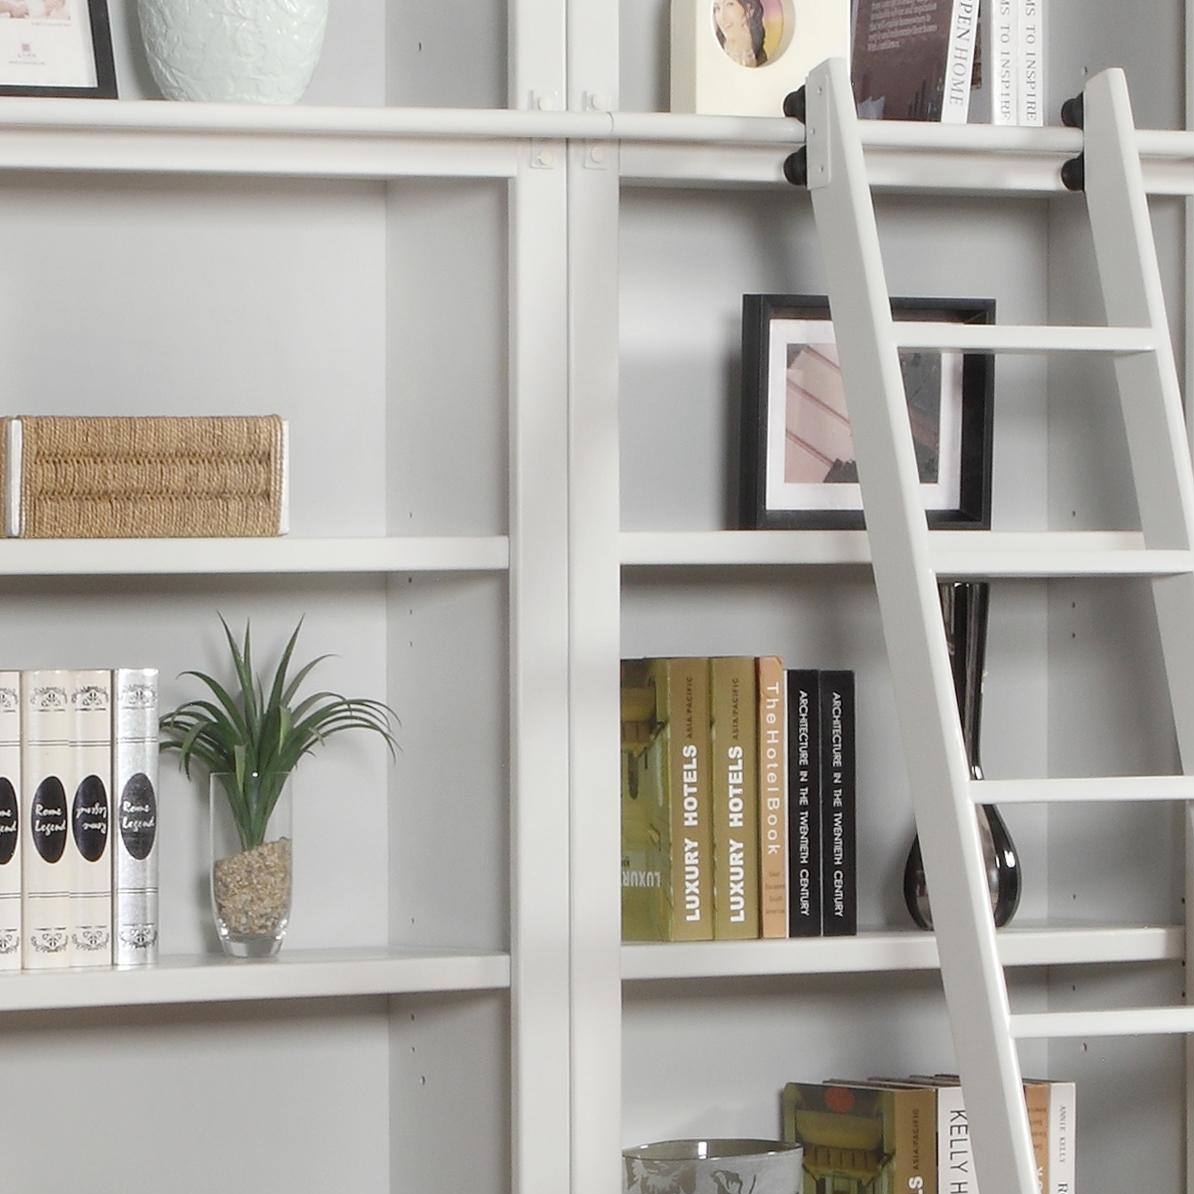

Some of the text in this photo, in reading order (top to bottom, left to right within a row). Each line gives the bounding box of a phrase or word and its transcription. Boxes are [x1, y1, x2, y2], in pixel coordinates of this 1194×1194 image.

[949, 0, 973, 107] PEN HOME
[1000, 24, 1010, 44] TO
[1026, 25, 1036, 45] TO
[1000, 51, 1010, 121] INSPIRE
[1026, 52, 1037, 122] INSPIRE
[682, 744, 698, 827] HOTELS
[728, 745, 743, 828] HOTELS
[798, 689, 810, 916] ARCHITECTURE IN THE TWENTIETH CENTURY
[832, 691, 844, 917] ARCHITECTURE IN THE TWENTIETH CENTURY
[35, 819, 66, 836] Legend
[122, 815, 155, 832] Legend
[622, 870, 661, 887] LUXUR
[683, 837, 700, 922] LUXURY
[728, 838, 745, 923] LUXURY
[950, 1109, 968, 1173] KELLY
[1059, 1105, 1067, 1163] ANNIE KELLY
